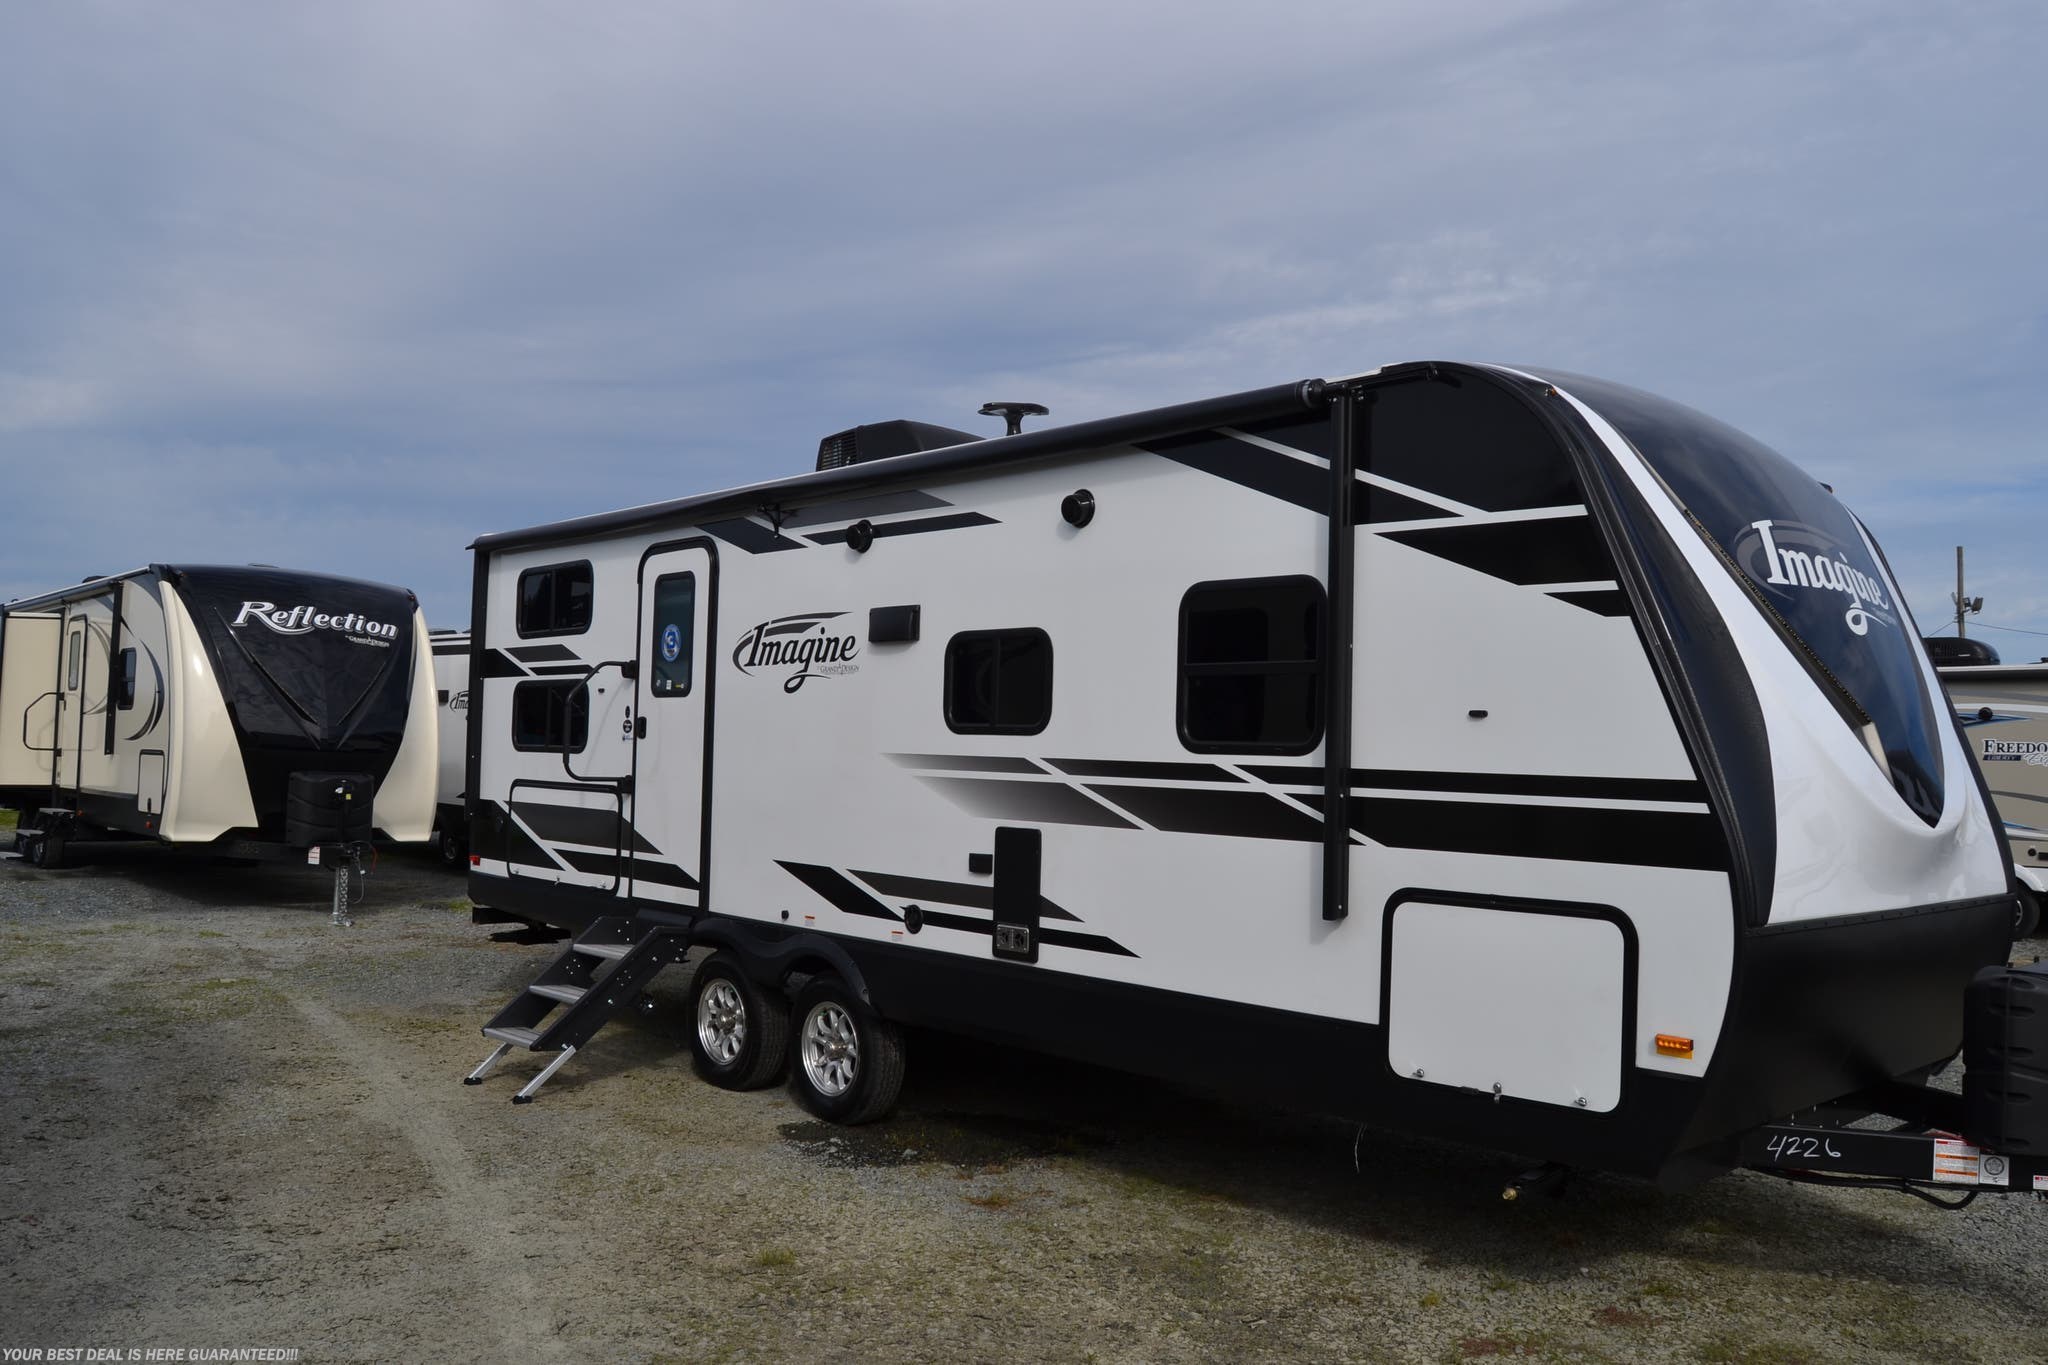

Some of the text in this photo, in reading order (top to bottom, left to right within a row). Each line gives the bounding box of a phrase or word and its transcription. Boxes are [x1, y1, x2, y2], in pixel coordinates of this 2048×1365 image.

[1751, 519, 1889, 636] Imagine
[231, 601, 399, 640] Reflection
[743, 621, 861, 694] Imagine
[1766, 1135, 1842, 1162] 4226
